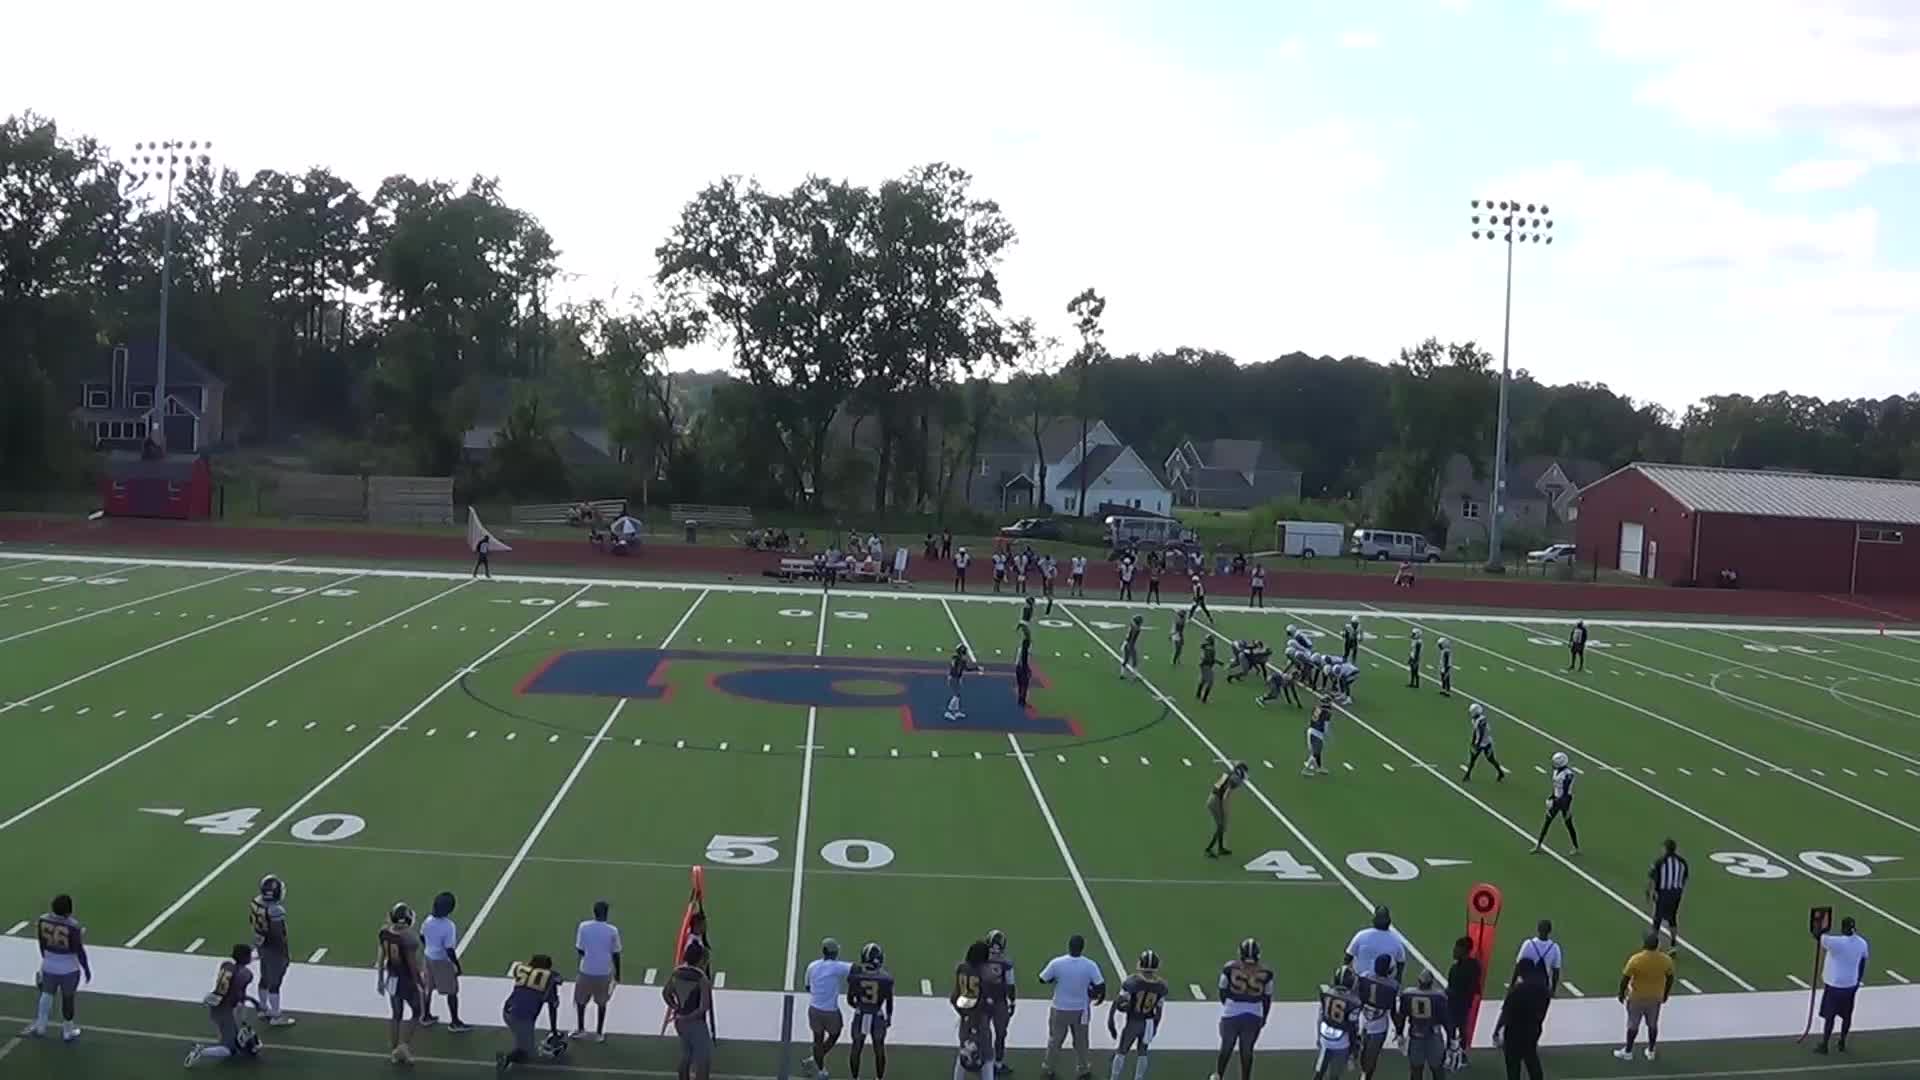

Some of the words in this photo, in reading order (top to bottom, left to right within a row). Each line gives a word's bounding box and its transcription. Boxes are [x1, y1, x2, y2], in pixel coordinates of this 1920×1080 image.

[513, 961, 551, 992] 50
[859, 979, 880, 1003] 3
[1410, 996, 1432, 1019] 0
